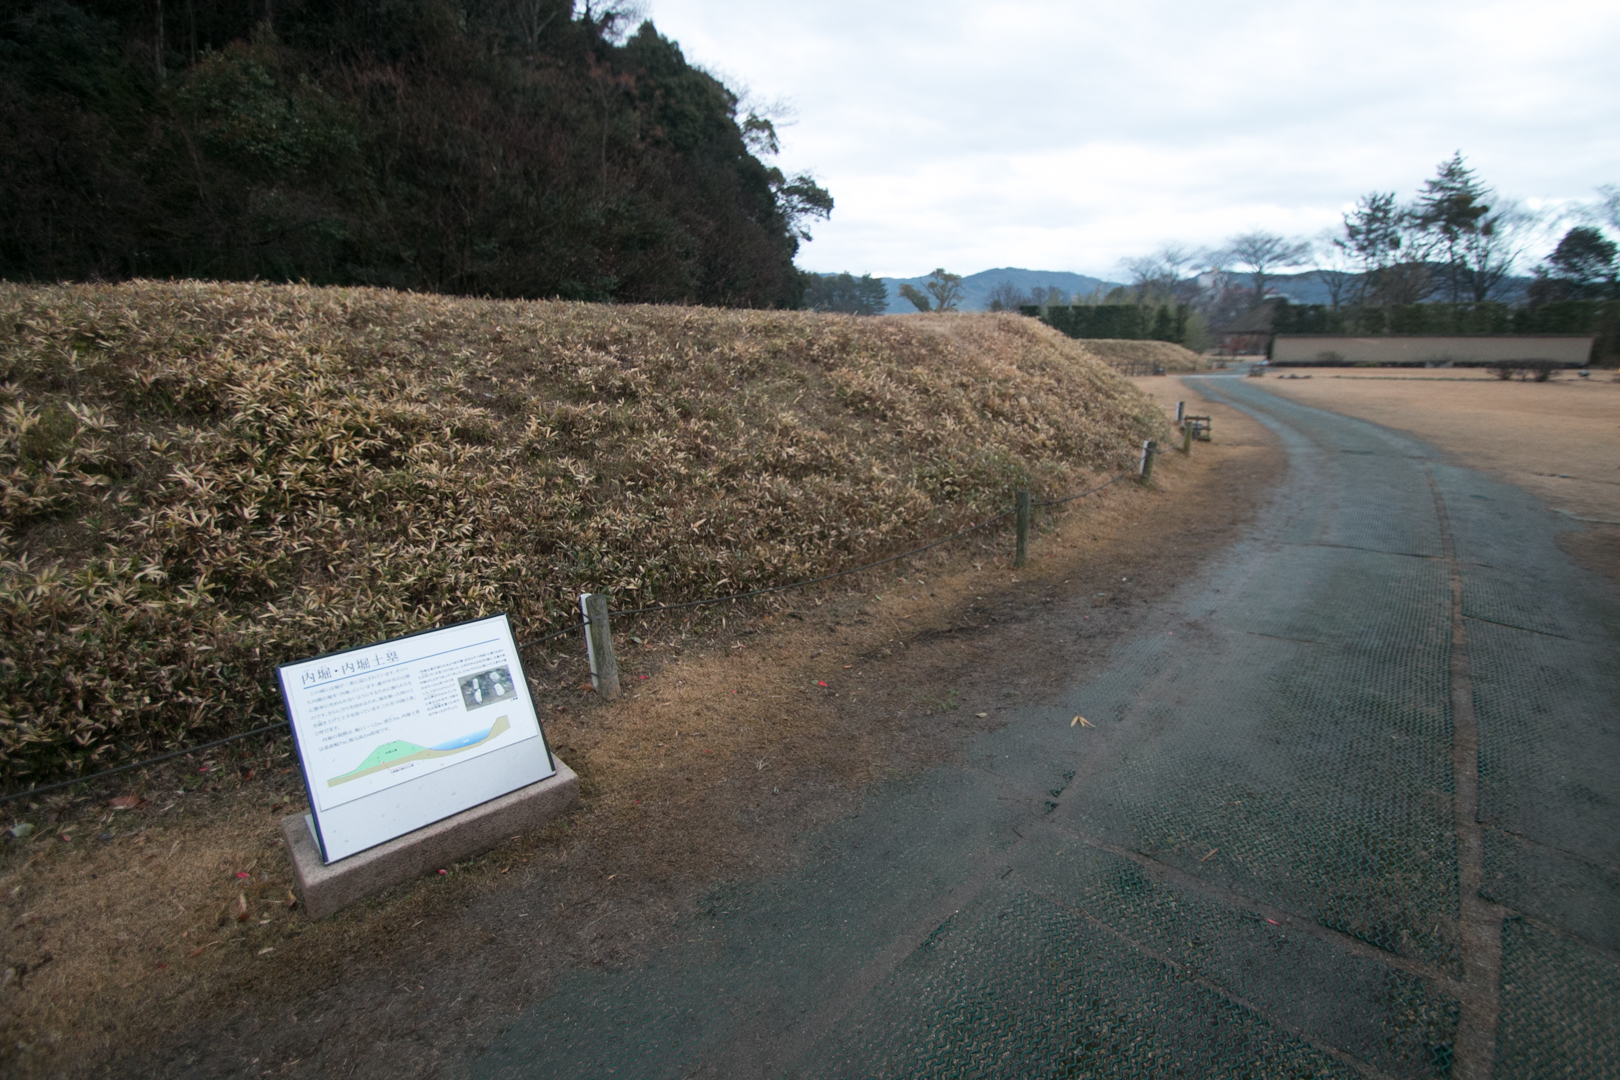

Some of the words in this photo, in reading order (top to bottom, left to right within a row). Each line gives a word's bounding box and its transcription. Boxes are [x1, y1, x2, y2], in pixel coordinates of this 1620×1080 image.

[300, 650, 400, 685] 内堀・内堀土塁
